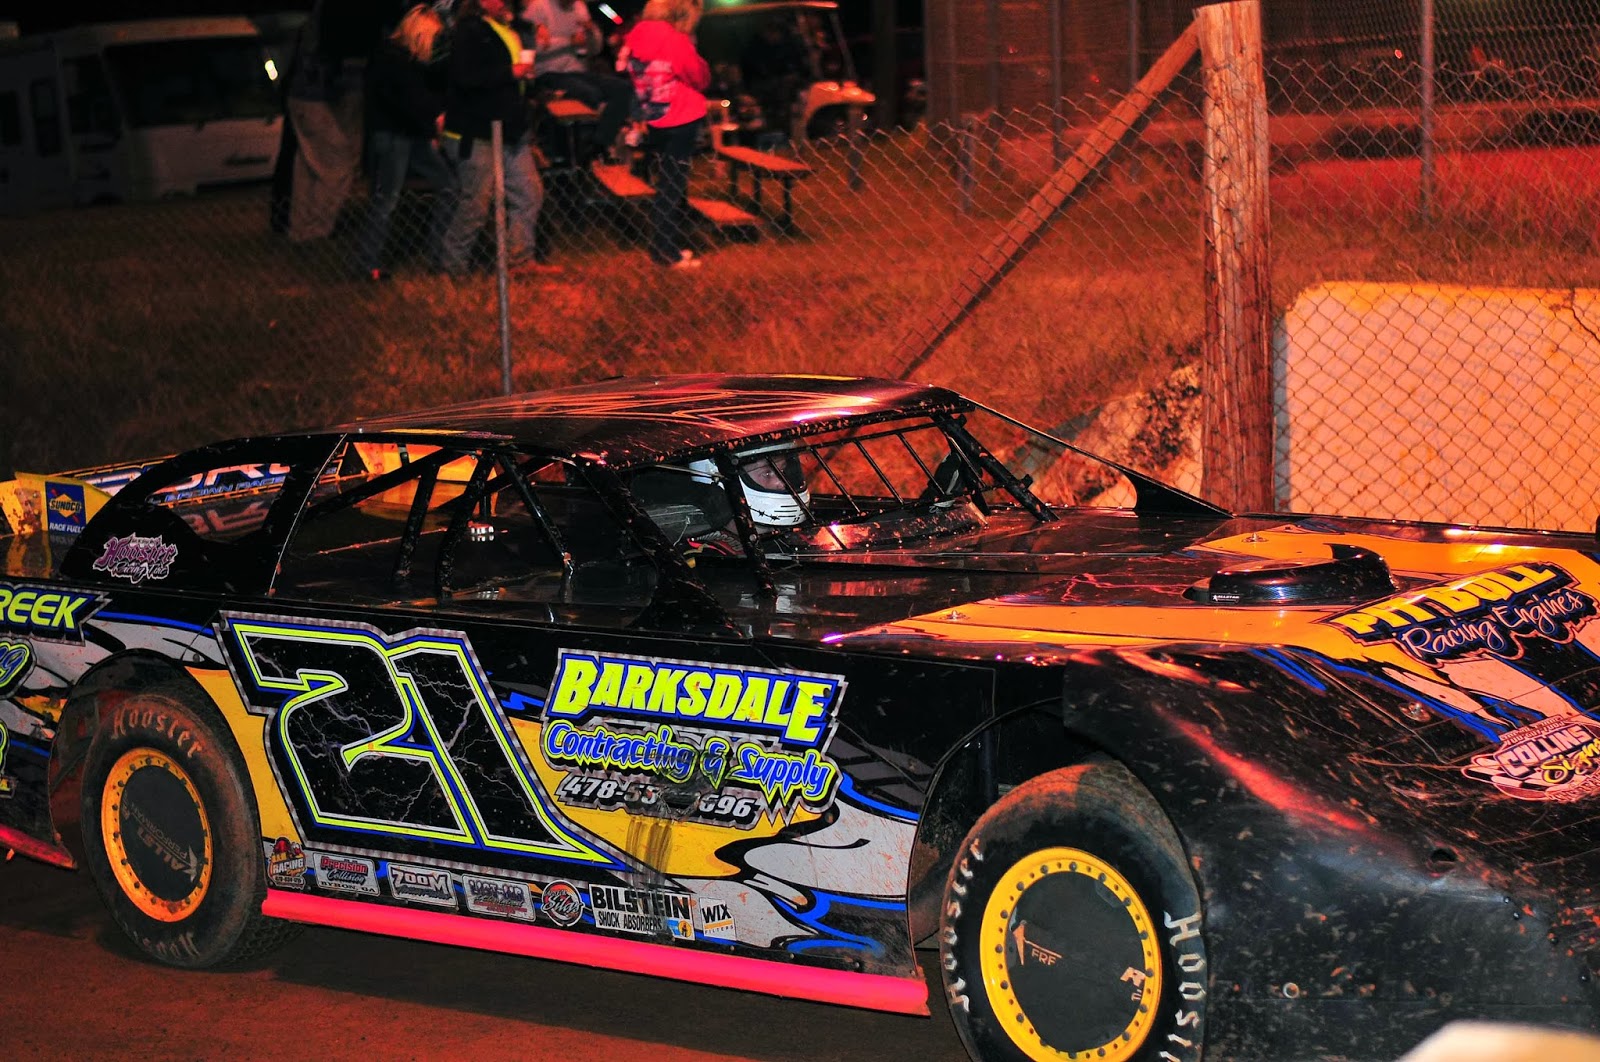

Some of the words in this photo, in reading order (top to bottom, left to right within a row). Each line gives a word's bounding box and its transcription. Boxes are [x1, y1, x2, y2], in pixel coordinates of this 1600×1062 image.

[50, 500, 81, 512] SUNOCO
[49, 523, 66, 531] RACE
[1402, 618, 1505, 658] Racing
[1491, 591, 1585, 635] Engines
[551, 658, 833, 742] BARKSDALE
[232, 621, 616, 864] 21
[1497, 725, 1593, 777] COLLINS
[547, 724, 693, 778] Contracting
[704, 743, 725, 773] &
[738, 747, 833, 796] Supply
[273, 859, 304, 874] RACING
[321, 857, 369, 873] Precision
[590, 886, 691, 920] BILSTEIN
[702, 903, 731, 923] WIX
[599, 911, 619, 928] SHOCK
[623, 914, 663, 931] ABSORBERS
